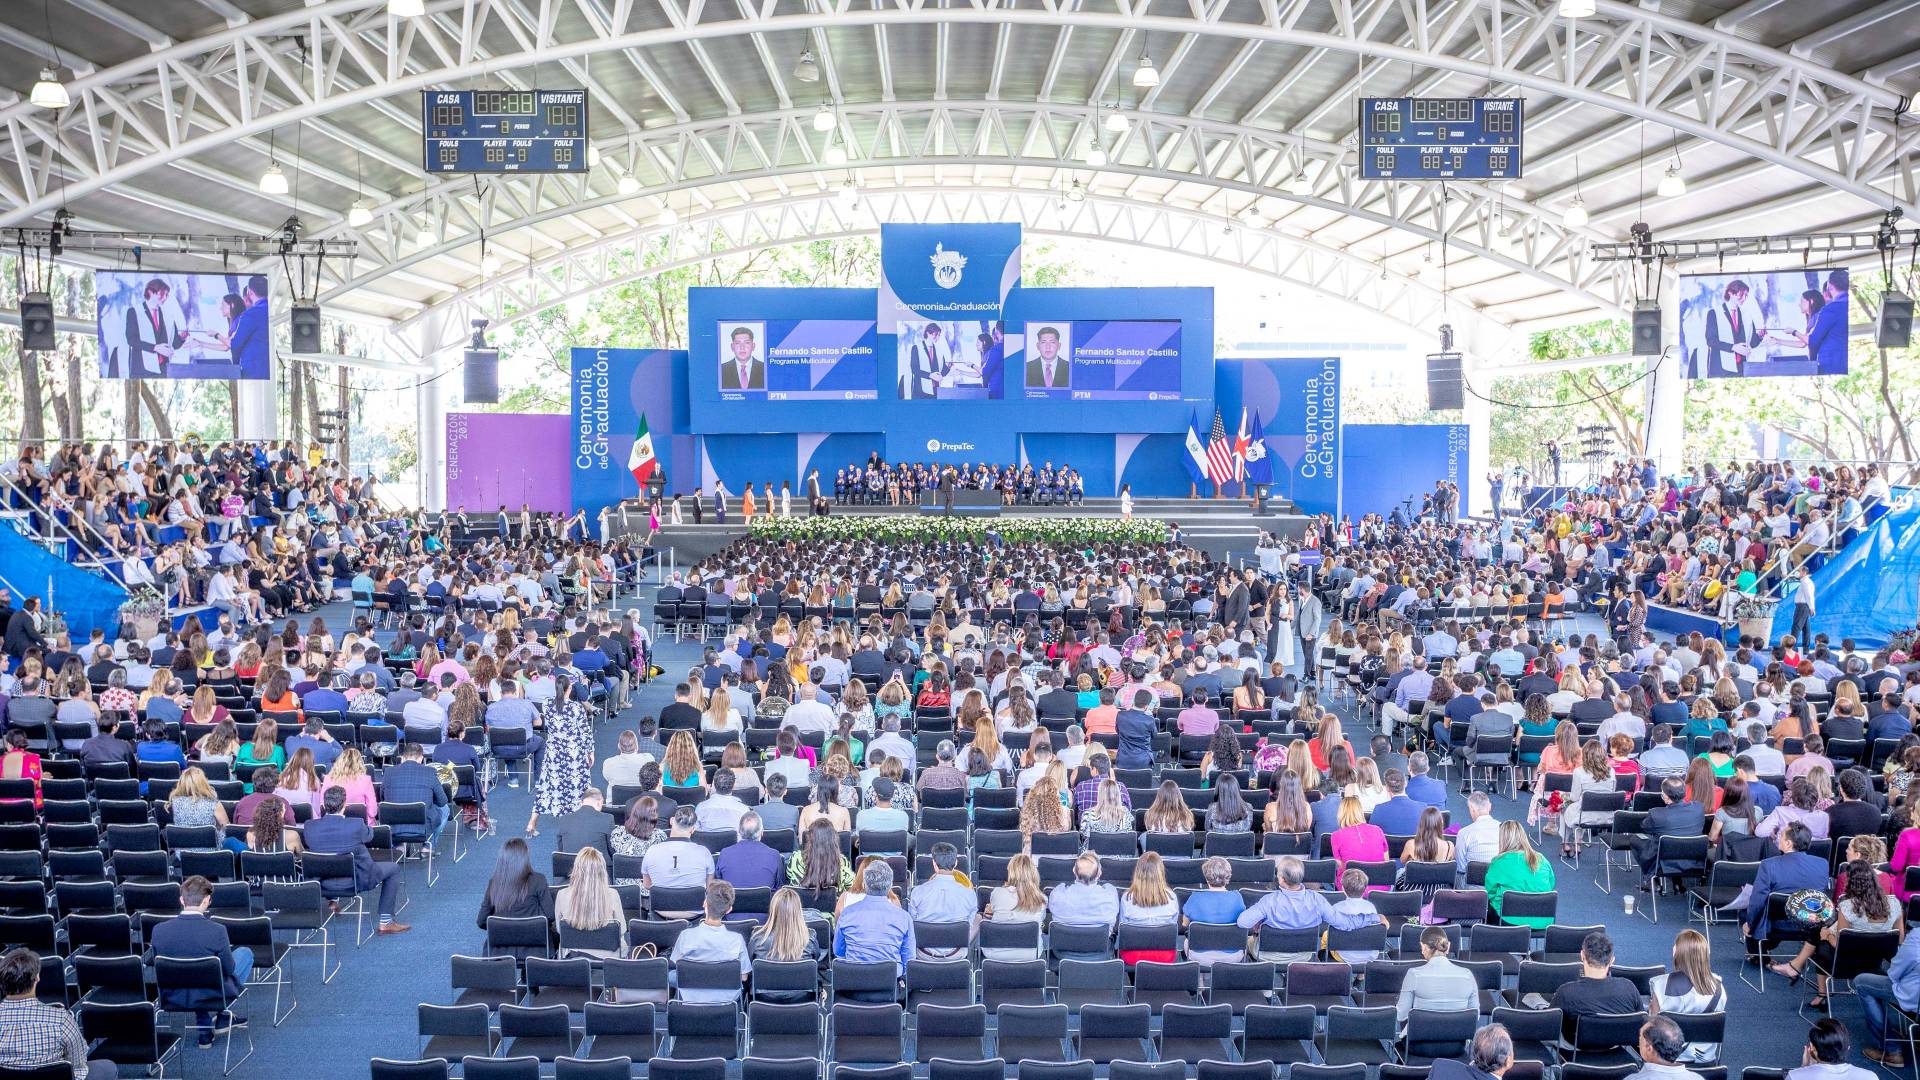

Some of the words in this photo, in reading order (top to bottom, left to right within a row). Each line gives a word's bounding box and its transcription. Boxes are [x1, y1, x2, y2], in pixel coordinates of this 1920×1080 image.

[437, 94, 460, 104] CASA
[541, 94, 583, 104] VISITANTE
[1375, 102, 1399, 111] CASA
[1484, 102, 1514, 111] VISITANTE
[895, 302, 944, 311] Ceremonia
[950, 301, 1001, 311] Graduación
[769, 347, 809, 355] Fernando
[811, 347, 840, 355] Santos
[841, 347, 873, 355] Castillo
[1075, 347, 1115, 356] Fernando
[1116, 348, 1145, 356] Santos
[1147, 348, 1178, 357] Castillo
[769, 358, 800, 366] Programa
[1074, 357, 1105, 366] Programa
[770, 392, 787, 400] PTM
[1074, 391, 1091, 399] PTM
[592, 349, 609, 456] Graduación
[1318, 359, 1336, 466] Graduación
[576, 367, 593, 469] Ceremonia
[458, 414, 468, 440] 2022
[1301, 377, 1319, 479] Ceremonia
[1458, 426, 1467, 451] 2022
[448, 413, 458, 480] GENERACIÓN
[942, 442, 975, 452] PrepaTec
[1447, 426, 1458, 485] ENERACIÓN
[598, 456, 609, 470] de
[1323, 465, 1333, 479] de
[673, 856, 678, 868] 1
